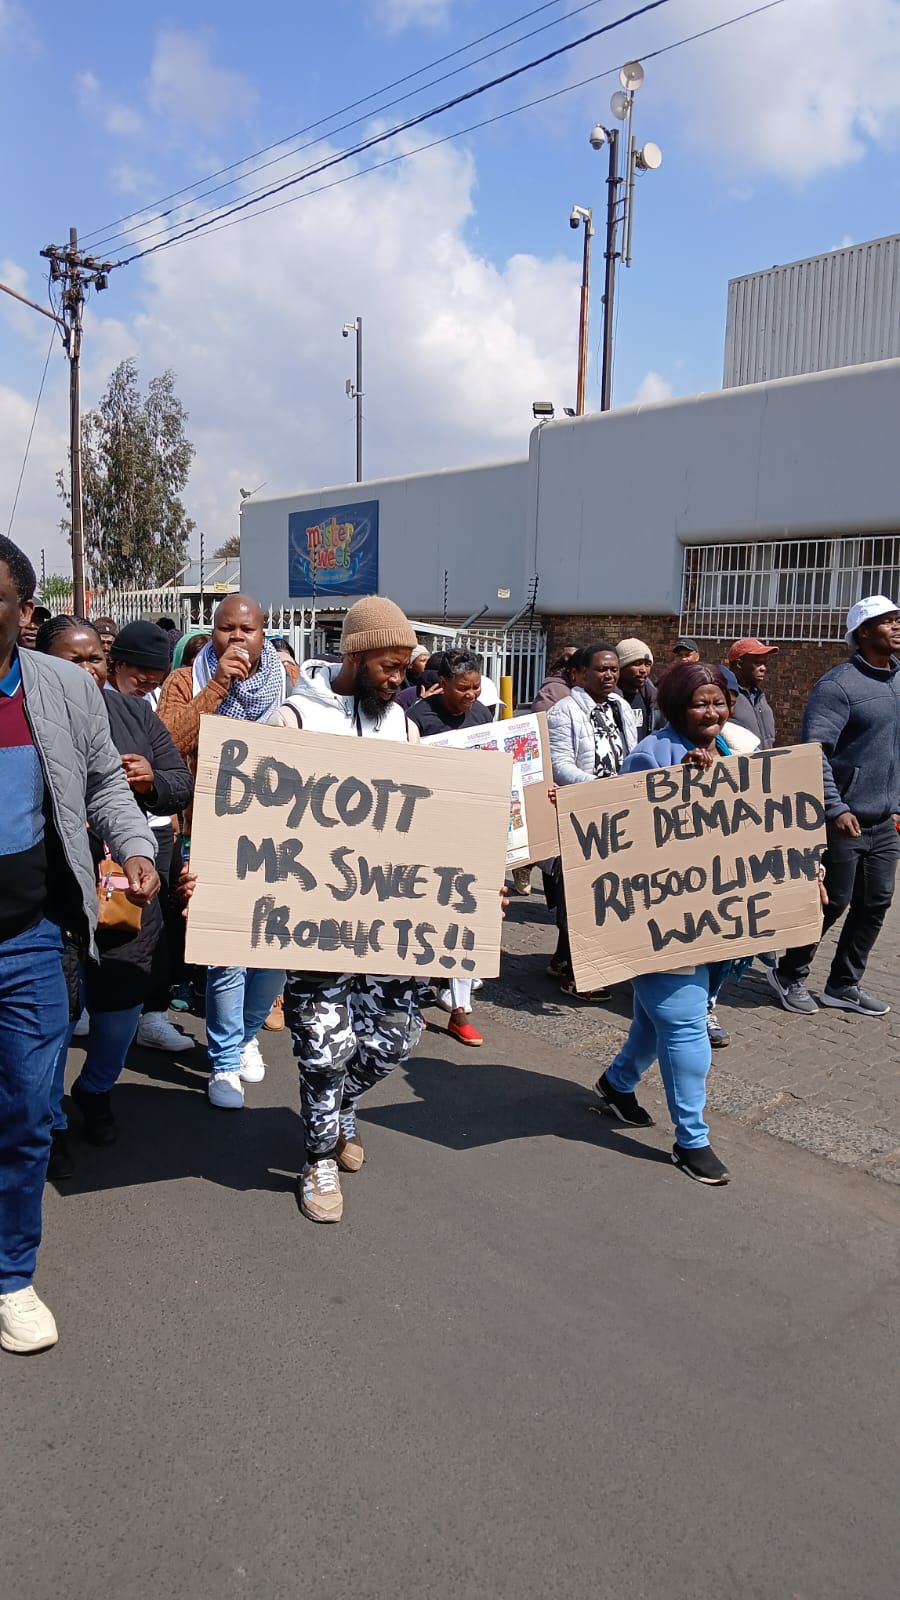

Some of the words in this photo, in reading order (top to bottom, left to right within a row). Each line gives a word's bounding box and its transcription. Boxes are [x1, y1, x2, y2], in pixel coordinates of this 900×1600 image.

[306, 517, 354, 548] mister
[215, 739, 433, 833] BOYCOTT
[646, 750, 792, 803] BRAIT
[570, 810, 633, 860] WE
[653, 791, 826, 848] DEMAND
[236, 835, 317, 892] MR
[326, 846, 477, 914] SWEETS
